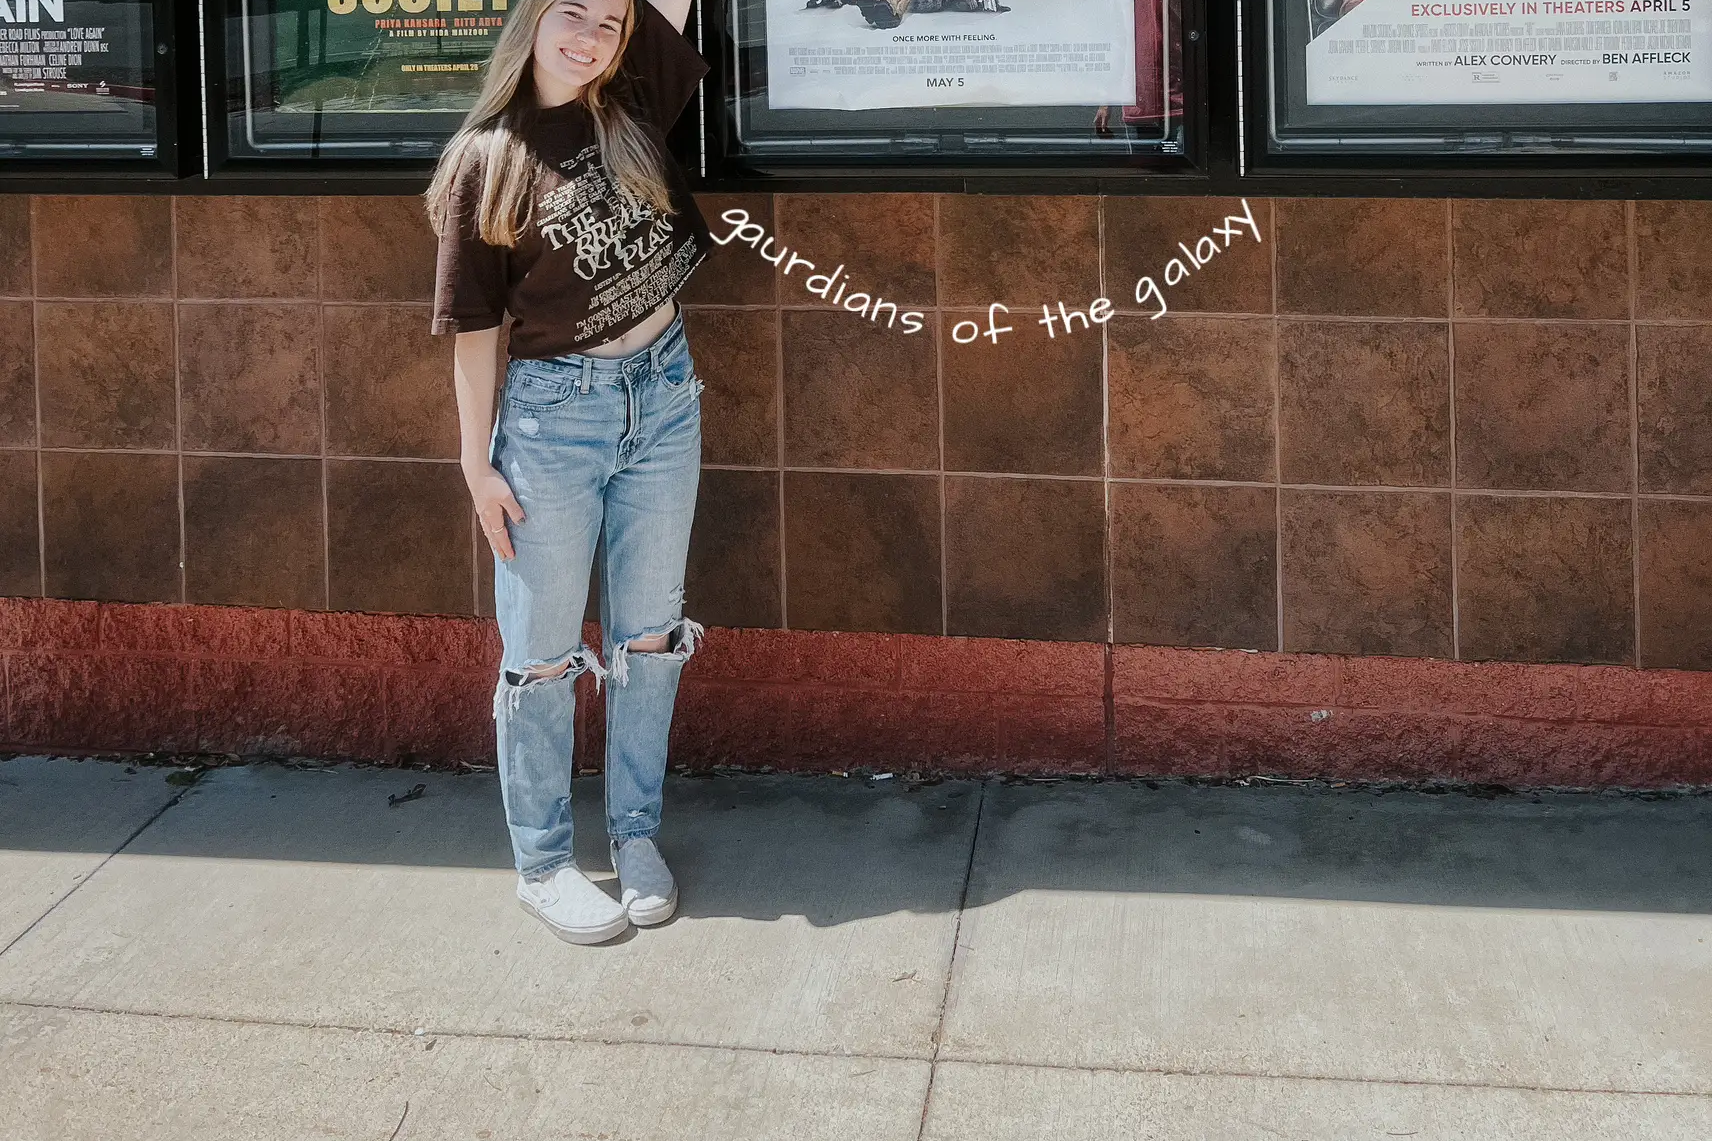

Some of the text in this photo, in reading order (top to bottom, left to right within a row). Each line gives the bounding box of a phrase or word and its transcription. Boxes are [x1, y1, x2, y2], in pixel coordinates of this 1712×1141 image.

[1411, 2, 1517, 17] EXCLUSIVELY
[1522, 1, 1537, 15] IN
[1543, 0, 1625, 14] THEATERS
[1630, 0, 1677, 13] APRIL
[892, 33, 997, 43] ONCE MORE WITH FEELING.
[1454, 54, 1487, 66] ALEX
[1490, 54, 1557, 66] CONVERY
[1602, 53, 1628, 65] BEN
[1632, 51, 1691, 64] AFFLECK
[926, 77, 965, 88] MAY 5
[541, 206, 595, 251] THE
[621, 213, 673, 271] PLAN
